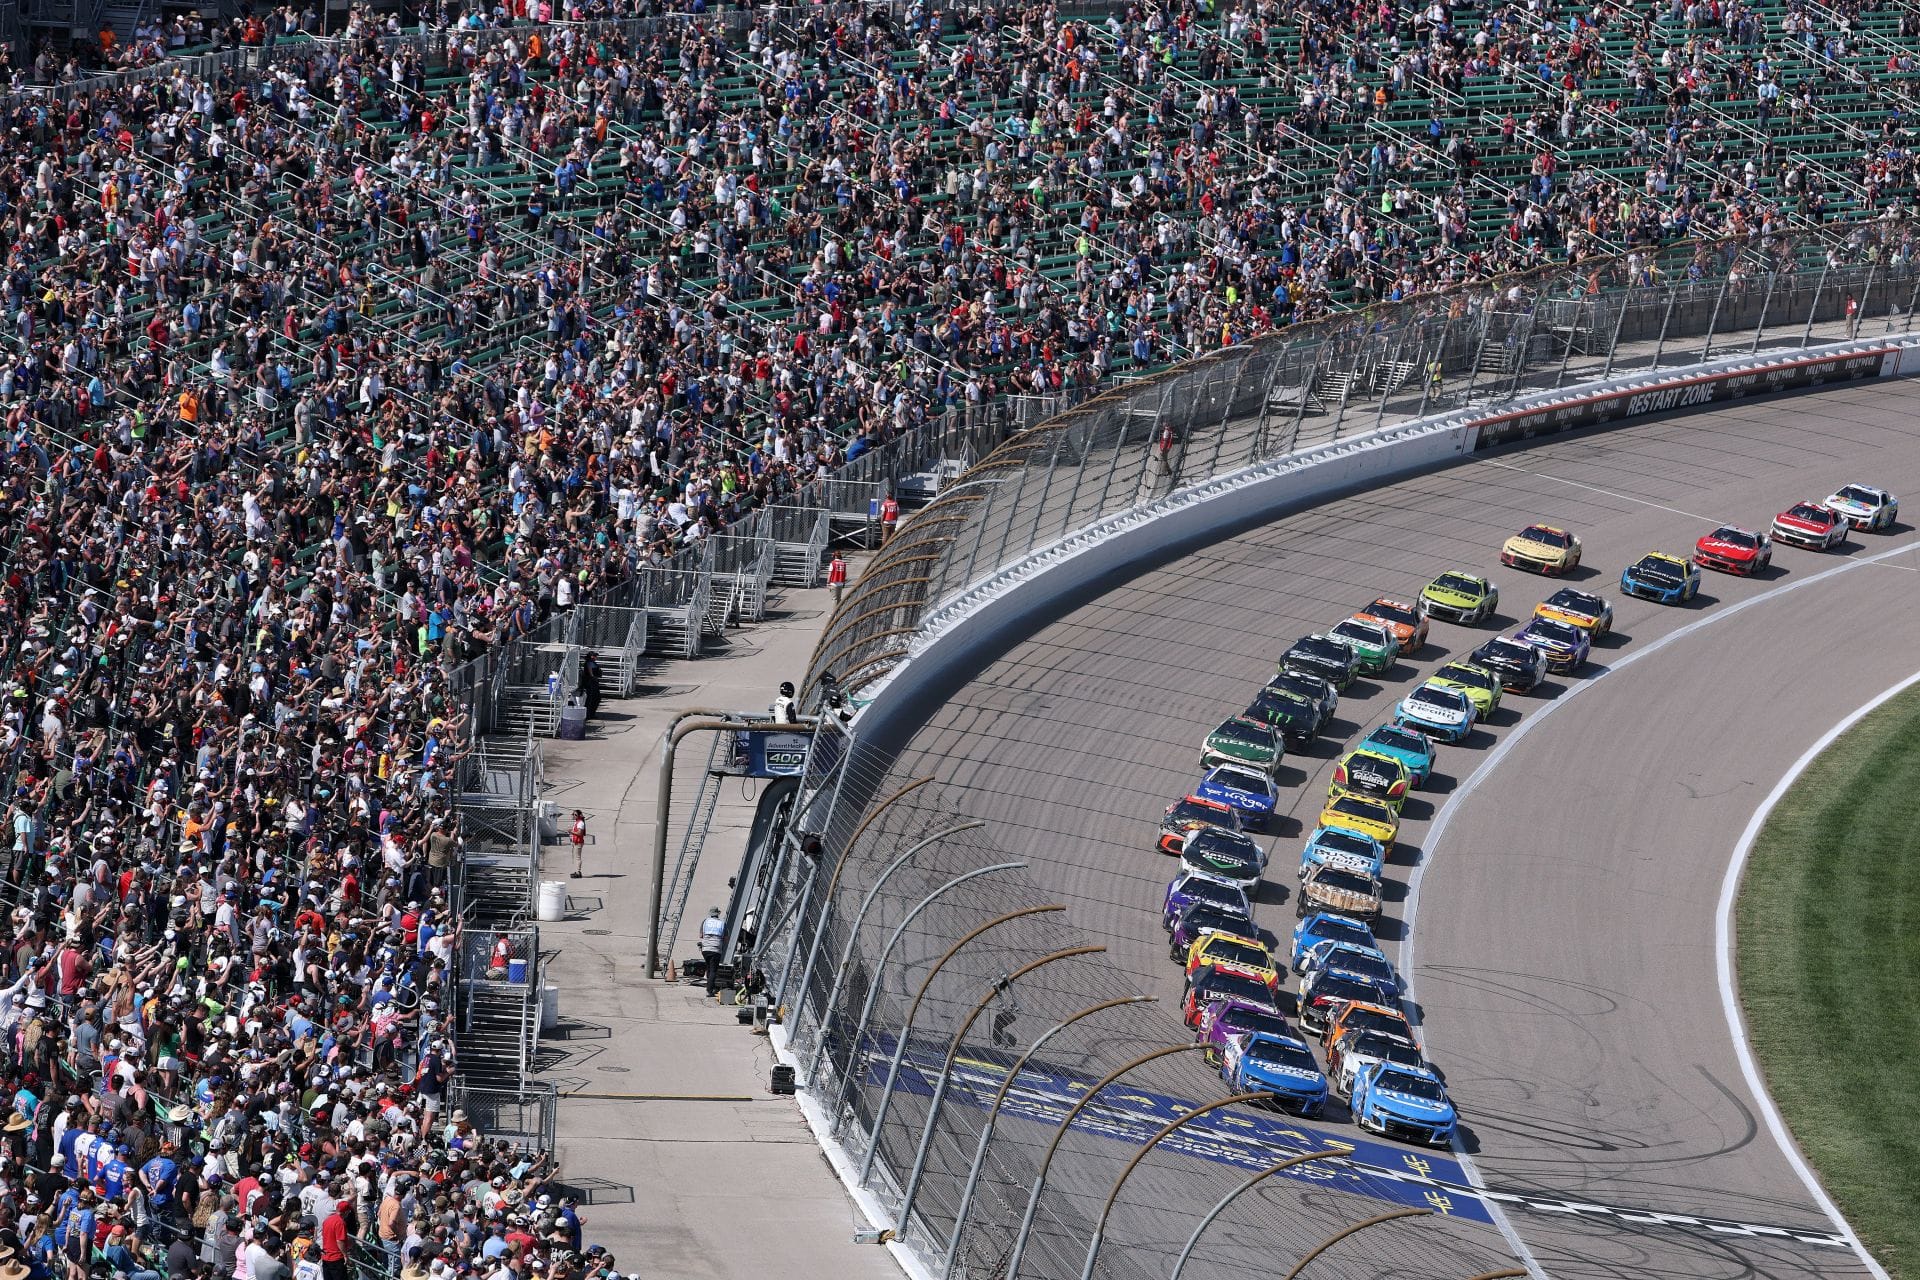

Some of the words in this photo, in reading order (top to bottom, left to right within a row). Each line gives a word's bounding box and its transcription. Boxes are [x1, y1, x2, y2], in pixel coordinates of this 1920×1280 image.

[1627, 387, 1683, 416] RESTART
[1680, 382, 1717, 405] ZONE
[1410, 704, 1455, 720] Health
[770, 754, 802, 763] 400
[1225, 793, 1268, 810] Kroger
[1313, 848, 1373, 868] BUSCH
